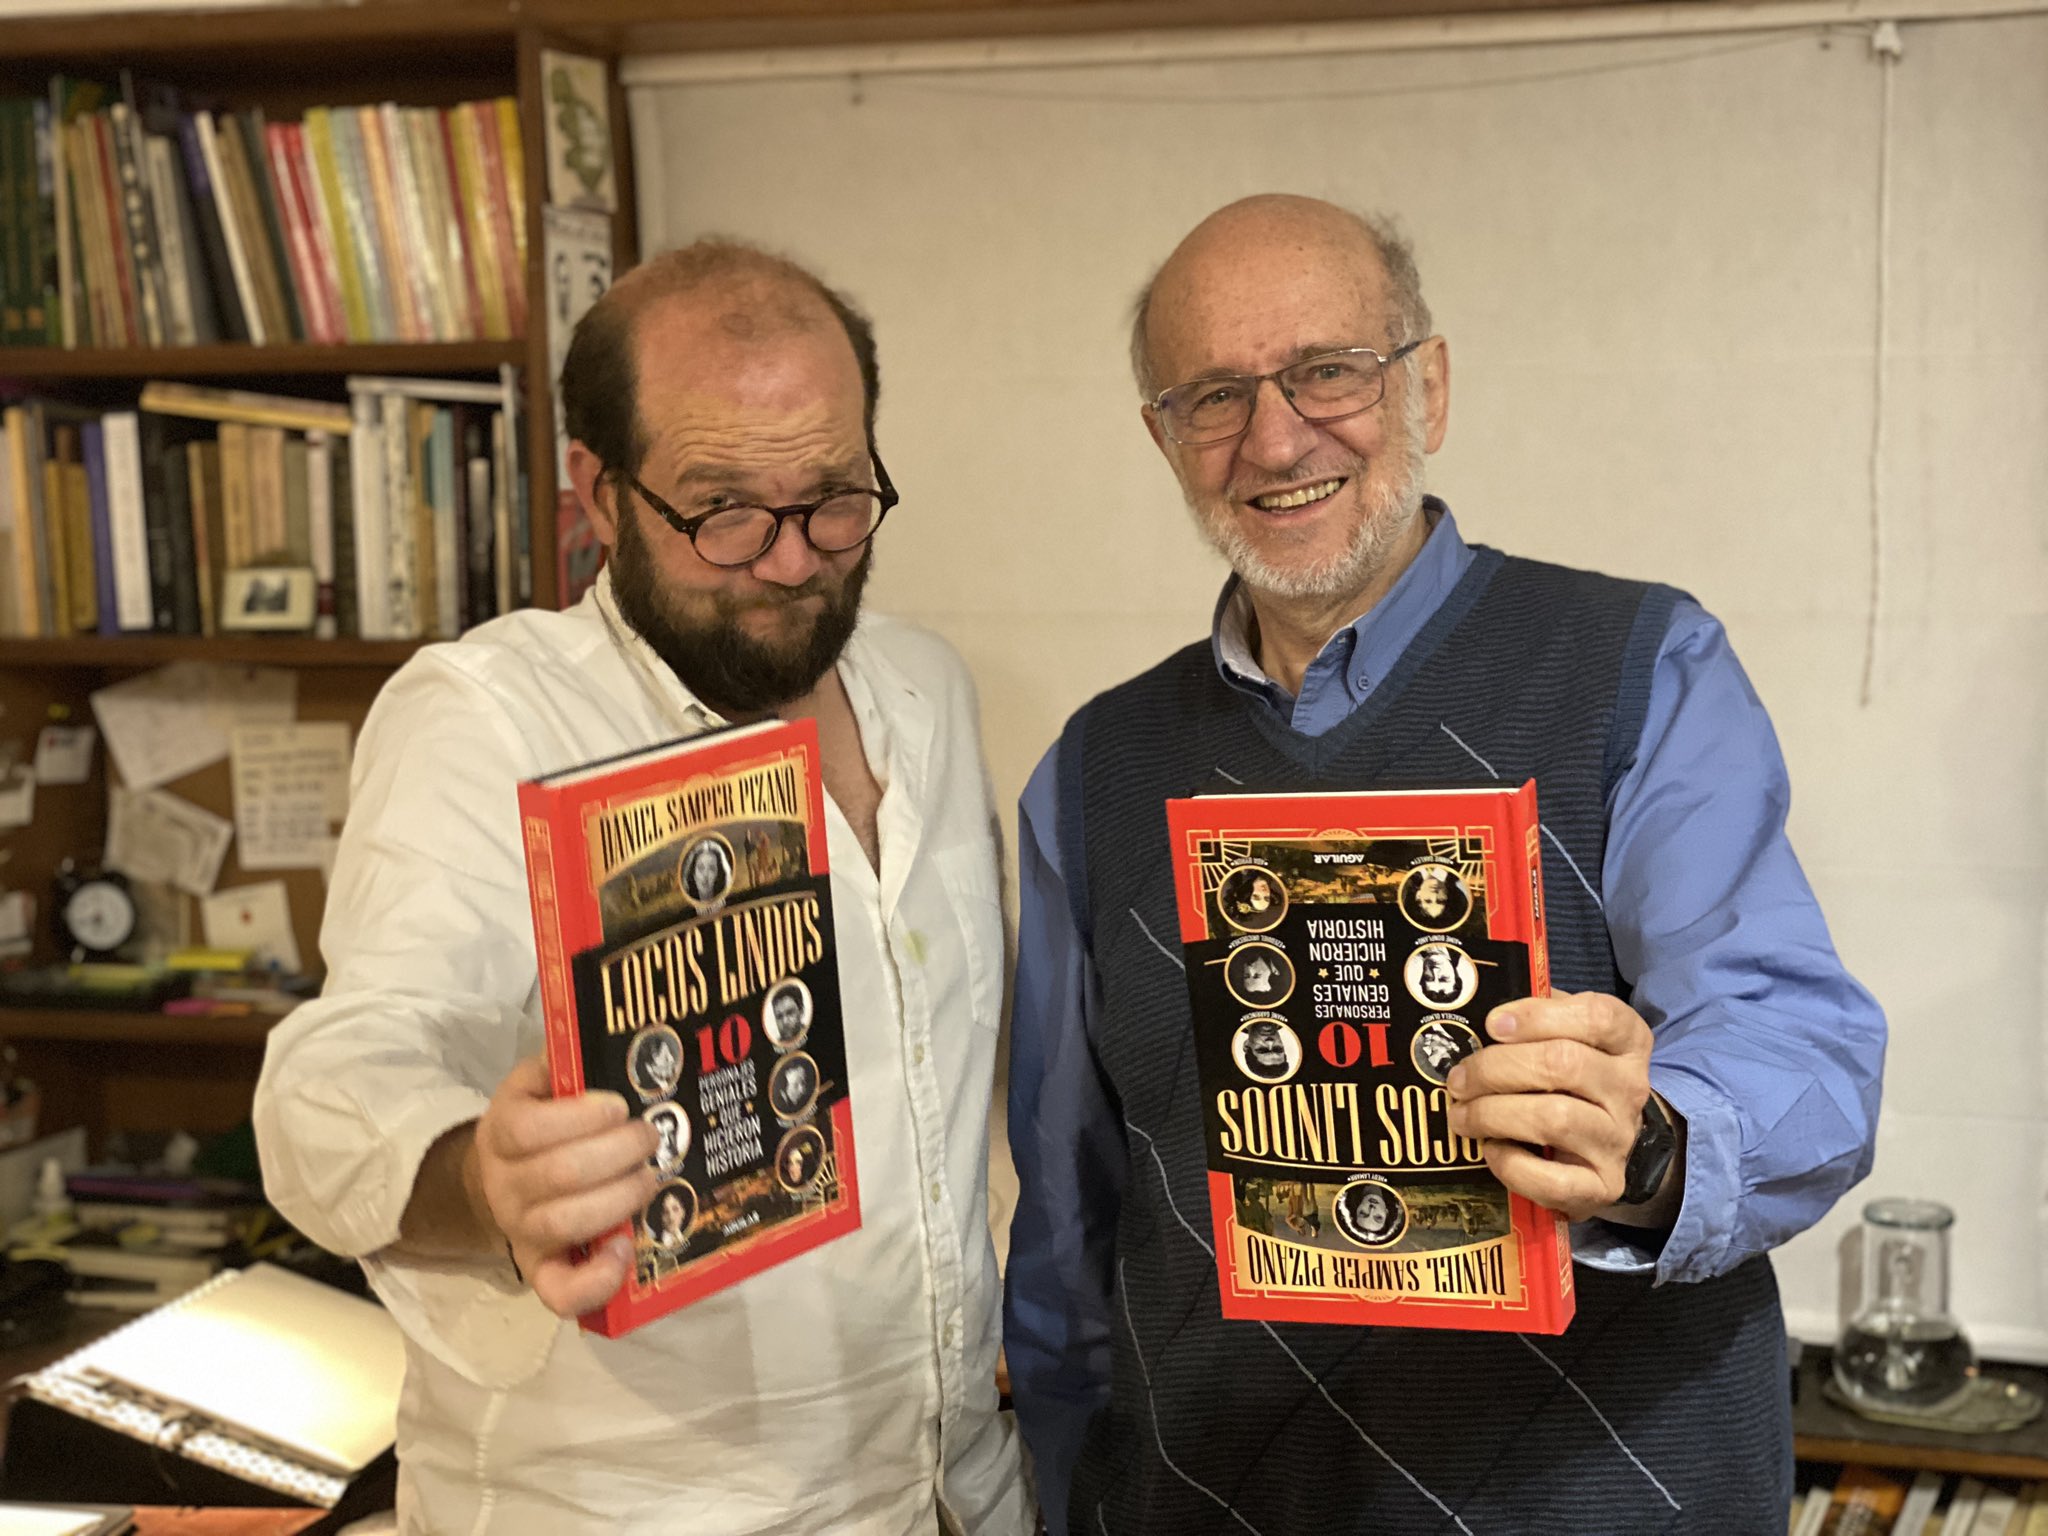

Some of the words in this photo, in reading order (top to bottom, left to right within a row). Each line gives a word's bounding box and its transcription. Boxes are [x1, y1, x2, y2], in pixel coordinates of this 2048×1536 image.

[600, 804, 663, 873] DANIEL
[667, 782, 735, 831] SAMPER
[739, 763, 797, 816] PIZANO
[1313, 854, 1365, 864] AGUILAR
[1306, 919, 1385, 939] HISTORIA
[601, 927, 708, 1035] LOCOS
[713, 898, 823, 1005] LINDOS
[1309, 942, 1387, 962] HICIERON
[1335, 964, 1364, 982] QUE
[1313, 984, 1390, 1002] GENIALES
[1315, 1004, 1391, 1019] PERSONAJES
[1441, 1013, 1467, 1024] GRACIELA
[696, 1013, 752, 1074] 10
[1318, 1022, 1395, 1068] 10
[703, 1113, 761, 1156] HICIERON
[1216, 1083, 1365, 1165] LINDOS
[1375, 1083, 1485, 1166] COS
[705, 1136, 764, 1179] HISTORIA
[1247, 1234, 1325, 1287] PIZANO
[1333, 1255, 1420, 1292] SAMPER
[1426, 1243, 1507, 1296] DANIEL
